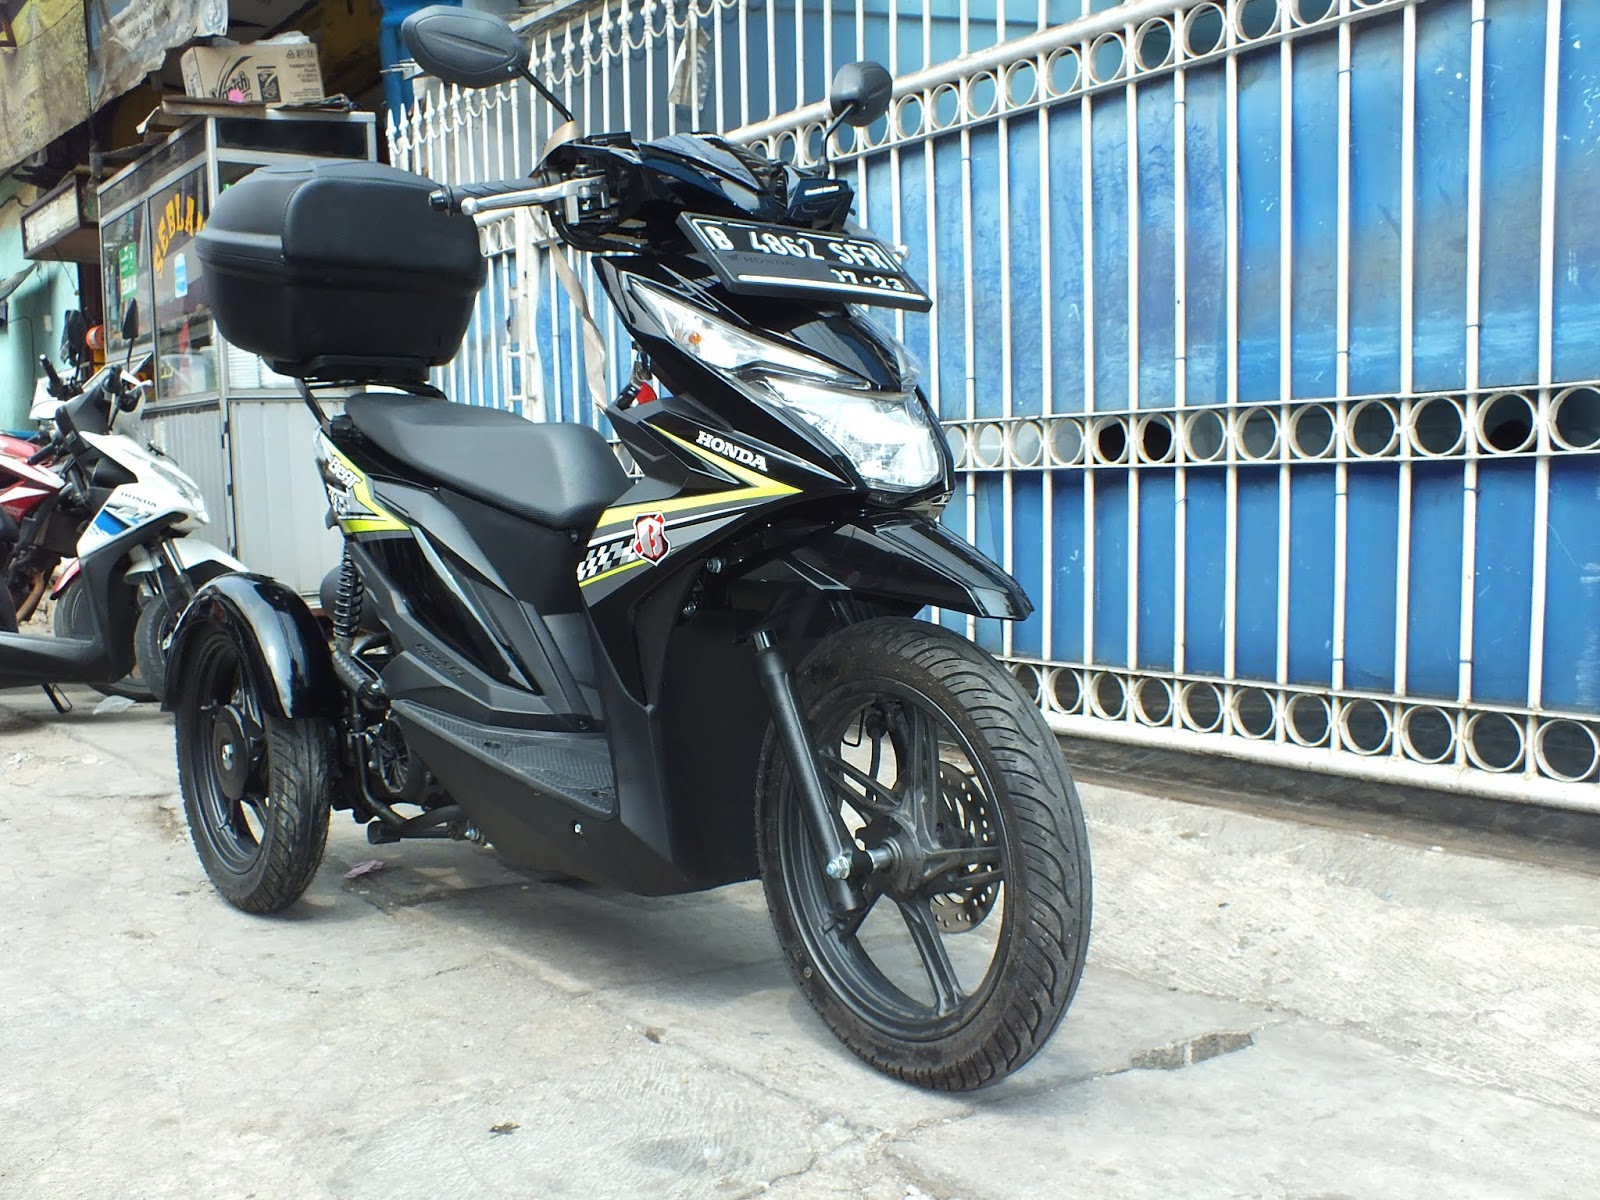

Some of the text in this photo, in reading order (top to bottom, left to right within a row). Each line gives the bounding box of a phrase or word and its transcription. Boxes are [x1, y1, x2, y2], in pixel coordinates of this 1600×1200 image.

[704, 226, 735, 251] B
[749, 230, 825, 261] 4862
[696, 430, 768, 472] HONDA
[120, 491, 157, 508] HONDA
